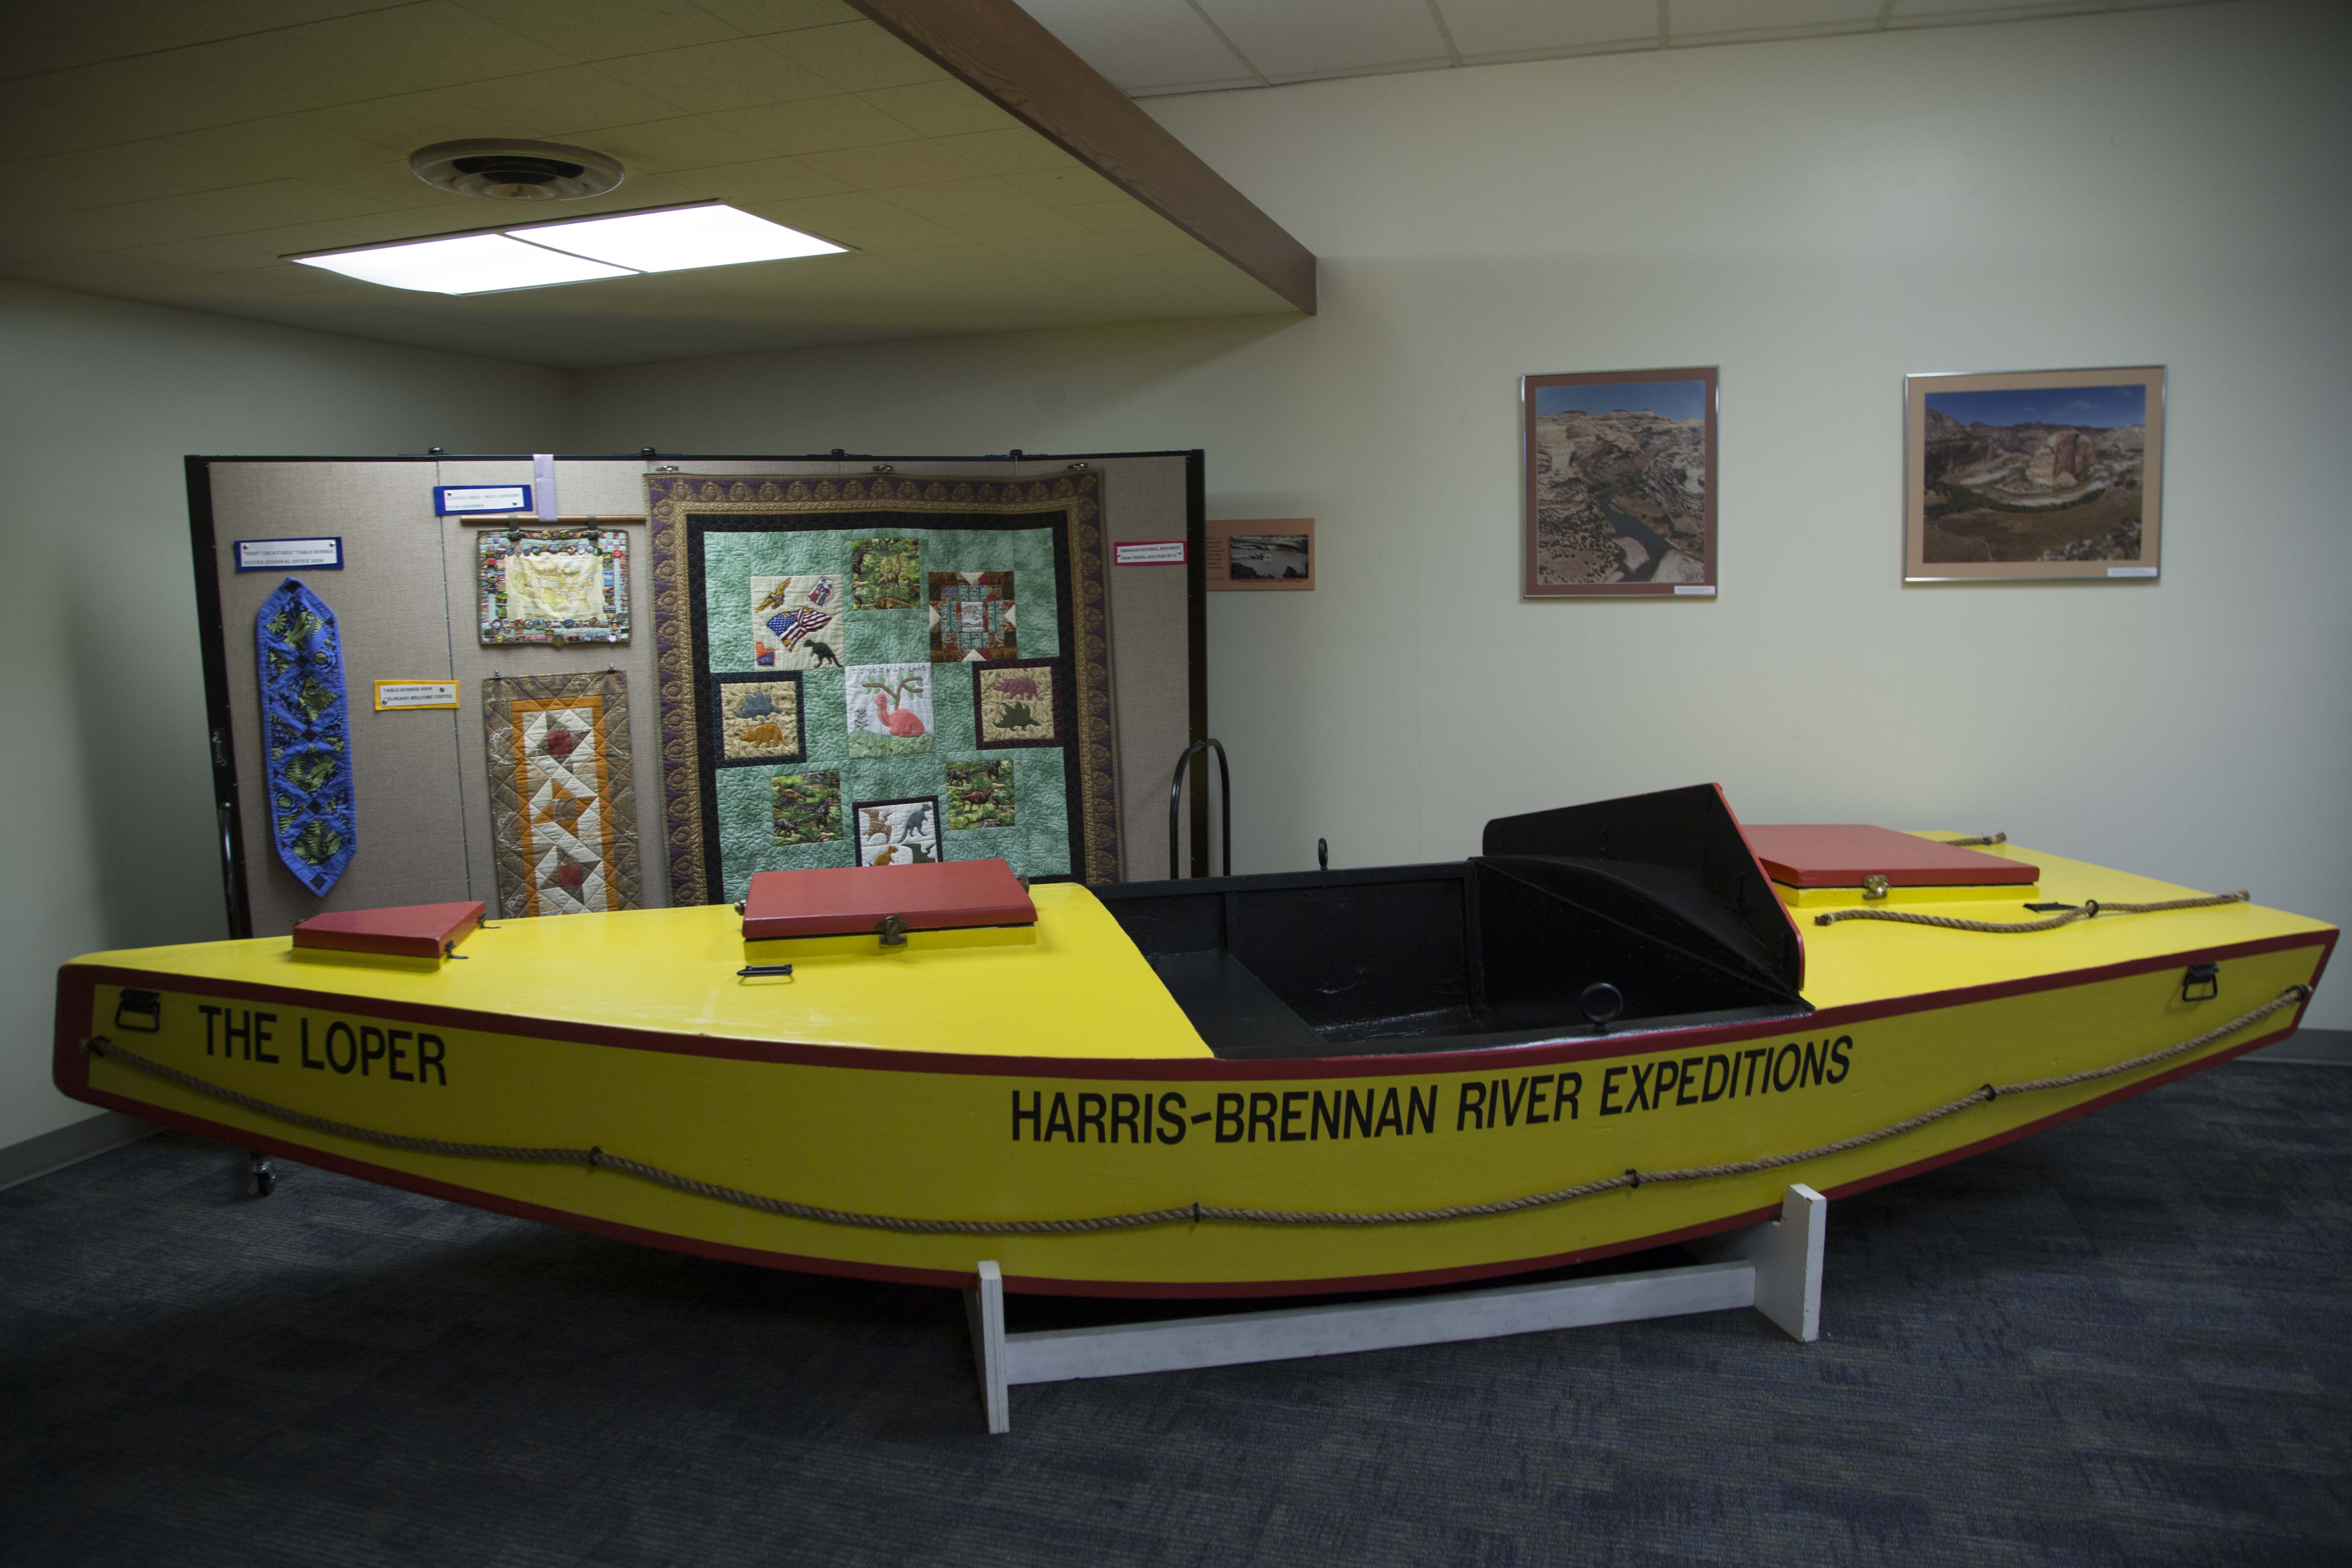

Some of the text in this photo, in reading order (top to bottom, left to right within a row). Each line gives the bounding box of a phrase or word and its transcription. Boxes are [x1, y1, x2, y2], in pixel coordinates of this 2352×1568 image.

[198, 1004, 447, 1086] THE LOPER
[1012, 1035, 1853, 1145] HARRIS-BRENNAN RIVER EXPEDITIONS
